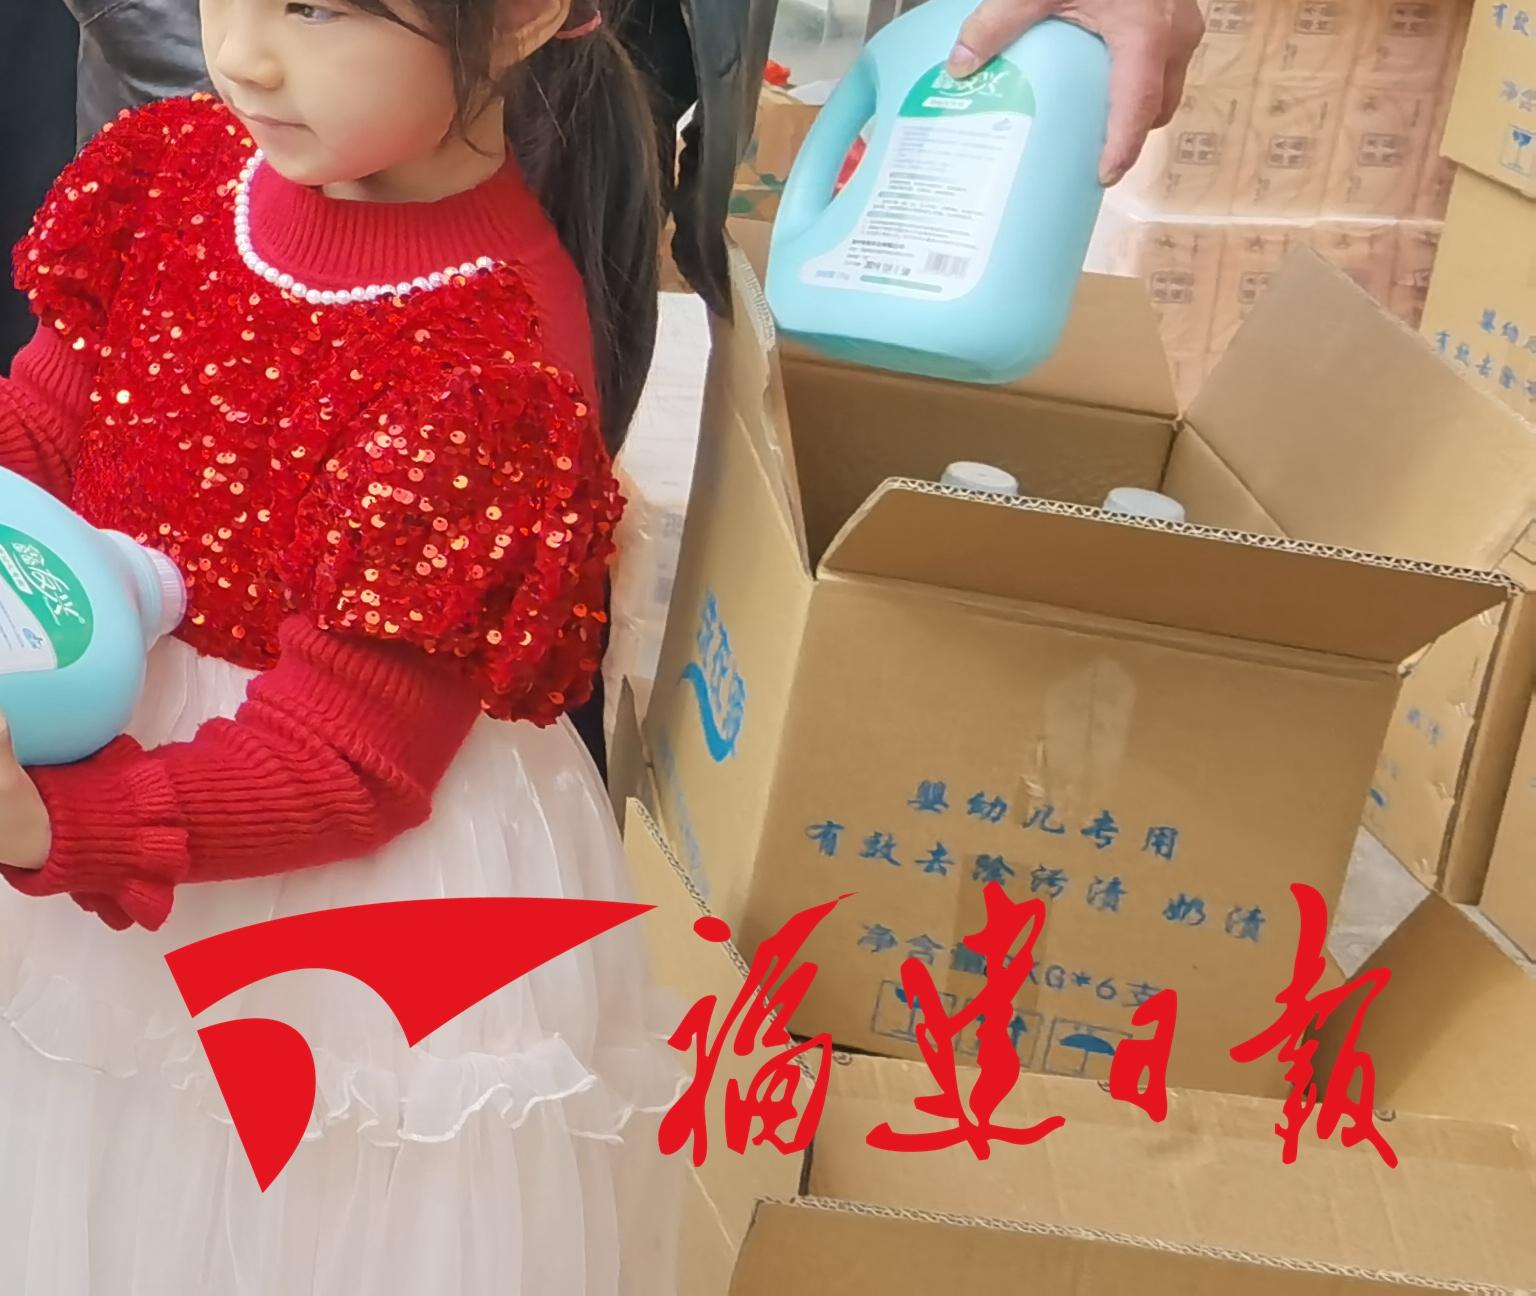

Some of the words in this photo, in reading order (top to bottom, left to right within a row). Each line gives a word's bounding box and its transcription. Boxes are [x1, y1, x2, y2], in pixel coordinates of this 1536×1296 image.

[907, 779, 1180, 861] 婴幼儿专用
[805, 819, 1128, 913] 有效去除污渍
[1162, 892, 1267, 944] 奶渍
